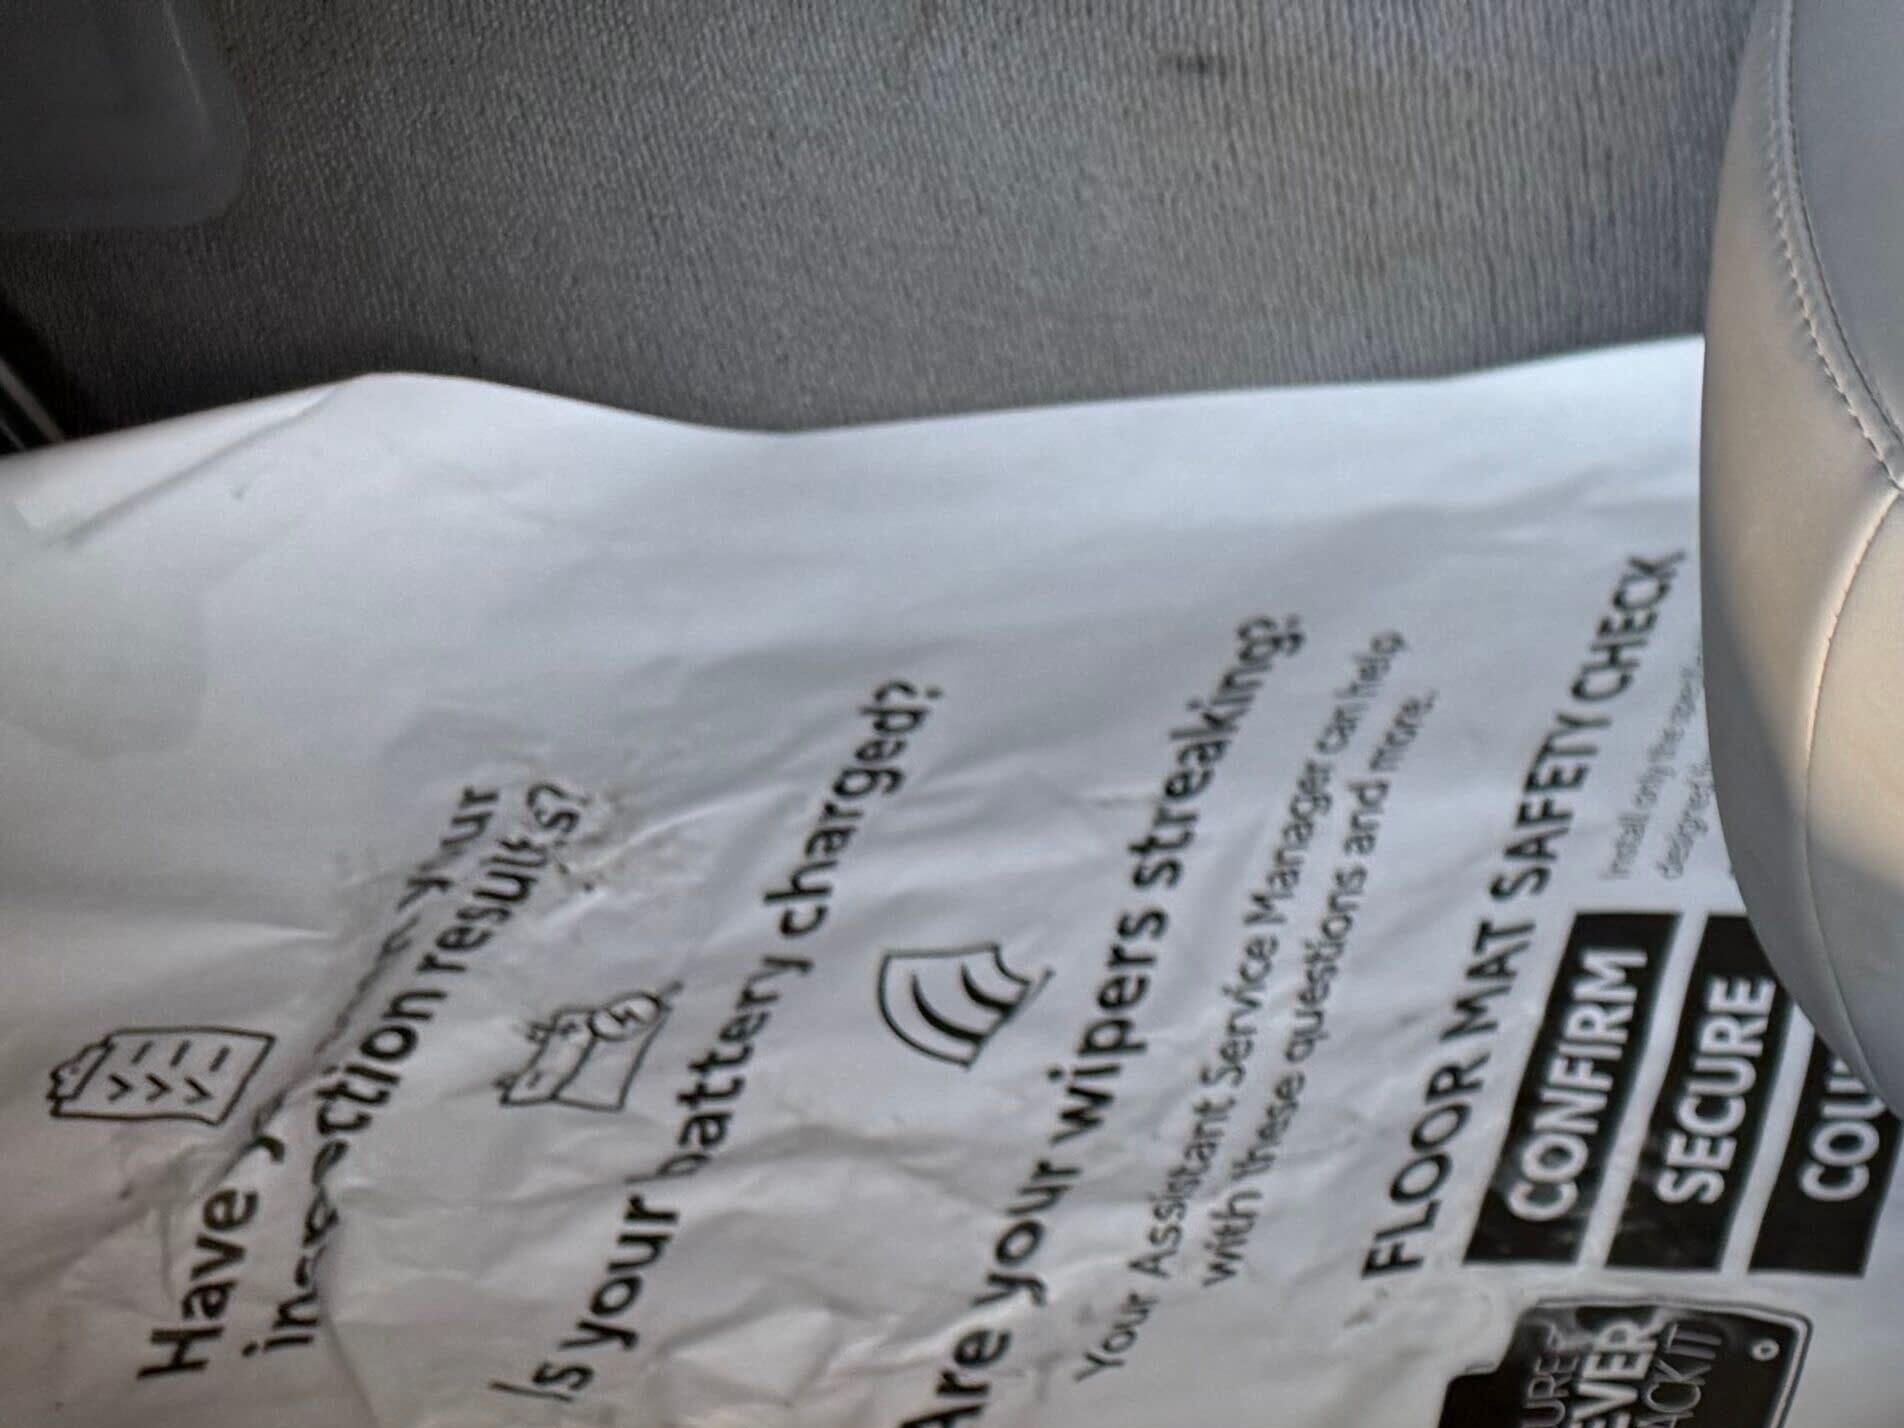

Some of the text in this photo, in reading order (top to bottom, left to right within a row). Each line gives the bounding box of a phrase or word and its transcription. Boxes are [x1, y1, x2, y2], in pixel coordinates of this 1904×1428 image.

[136, 785, 499, 1380] Have yur
[416, 781, 592, 976] results?
[489, 679, 943, 1403] Is your battery charged?
[971, 1159, 1079, 1308] your
[1047, 910, 1168, 1145] wipers
[1128, 614, 1307, 892] streaking?
[1074, 630, 1410, 1382] Your Assistant Service Manager can help
[1202, 688, 1439, 1288] with these questions and more.
[1361, 548, 1687, 1280] FLOOR MAT SAFETY CHECK
[1507, 948, 1649, 1222] CONFIRM
[1656, 973, 1777, 1204] SECURE
